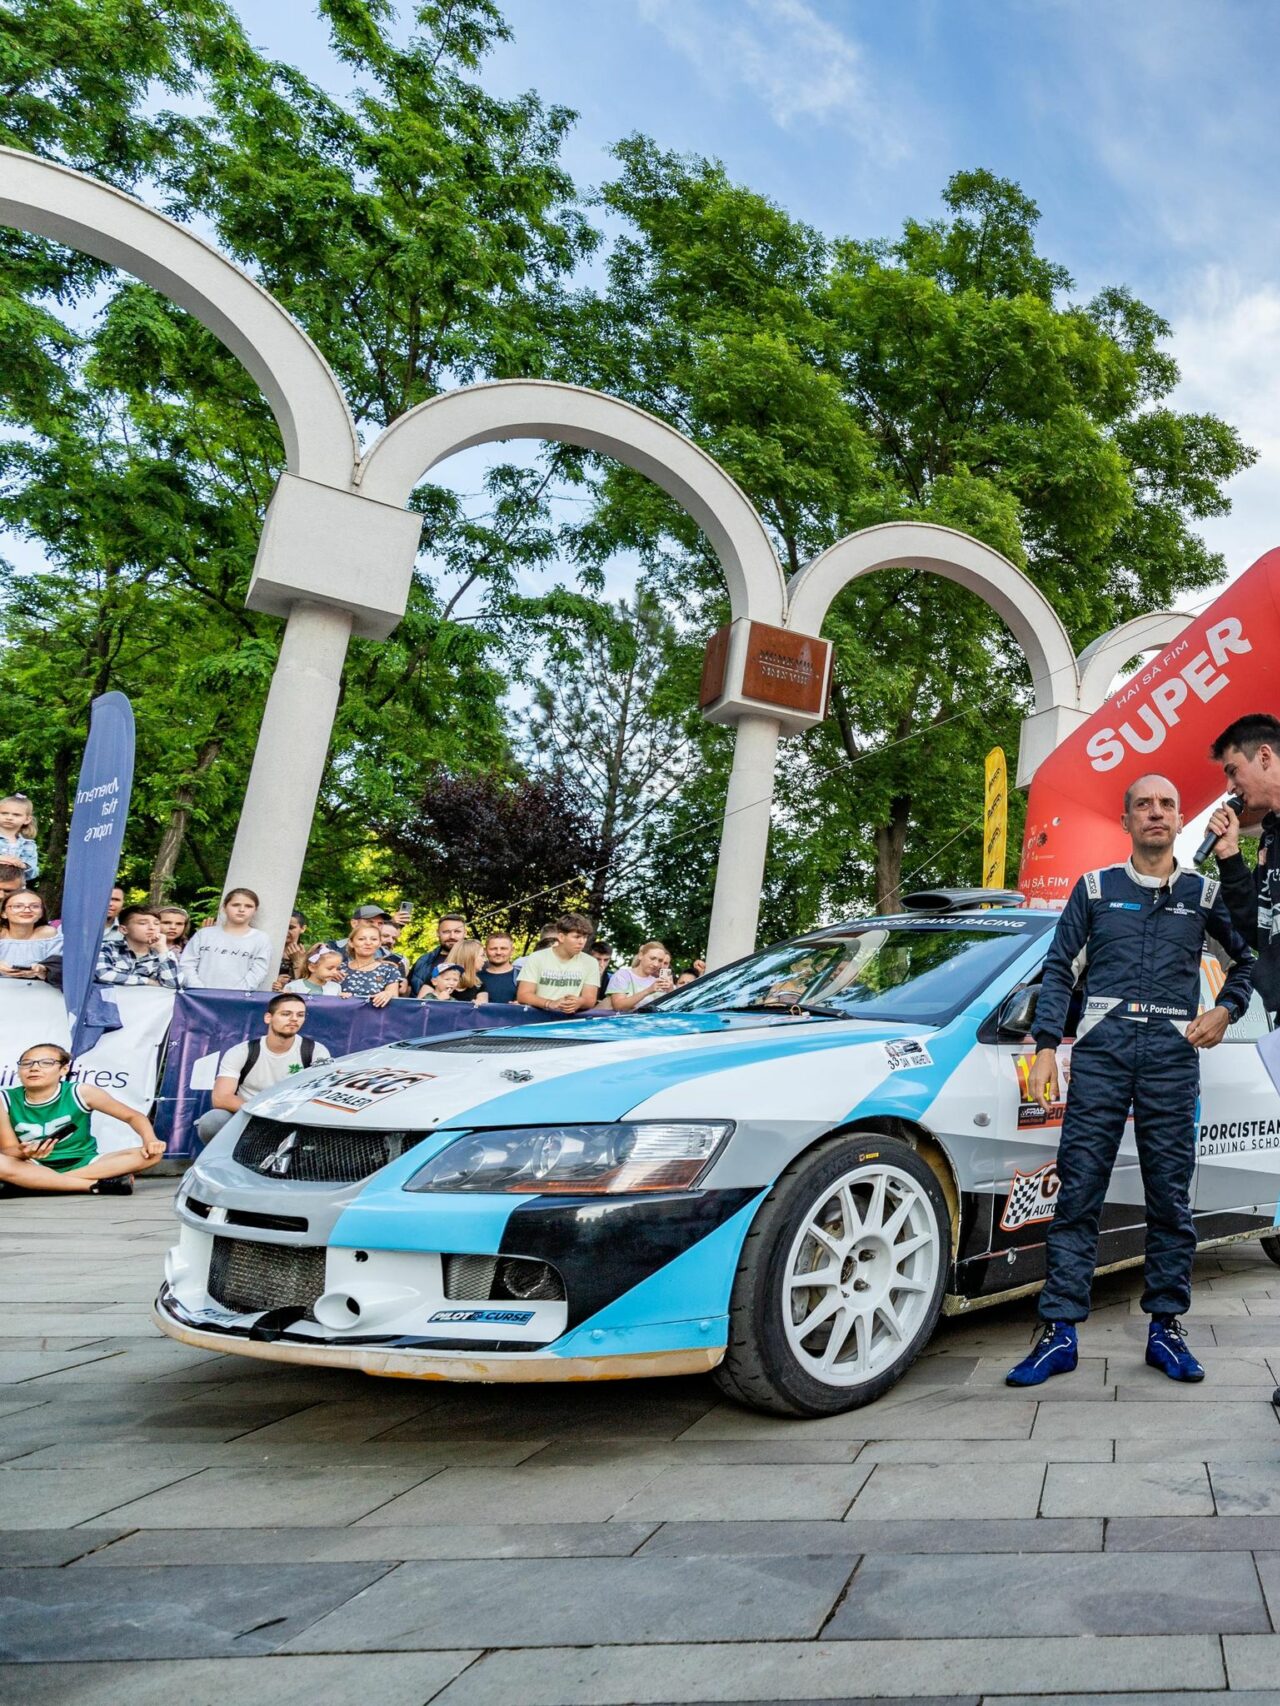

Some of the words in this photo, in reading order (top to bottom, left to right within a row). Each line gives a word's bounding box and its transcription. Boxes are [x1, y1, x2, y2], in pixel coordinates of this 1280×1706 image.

[1115, 686, 1140, 709] HAI
[1142, 665, 1162, 685] SĂ
[1163, 640, 1189, 666] FIM
[1086, 617, 1253, 772] SUPER
[1047, 876, 1070, 887] FIM
[961, 917, 1027, 929] RACING
[1139, 1003, 1149, 1013] V.
[887, 1056, 900, 1070] 33
[1200, 1141, 1247, 1157] DRIVING
[484, 1311, 532, 1323] CURSE
